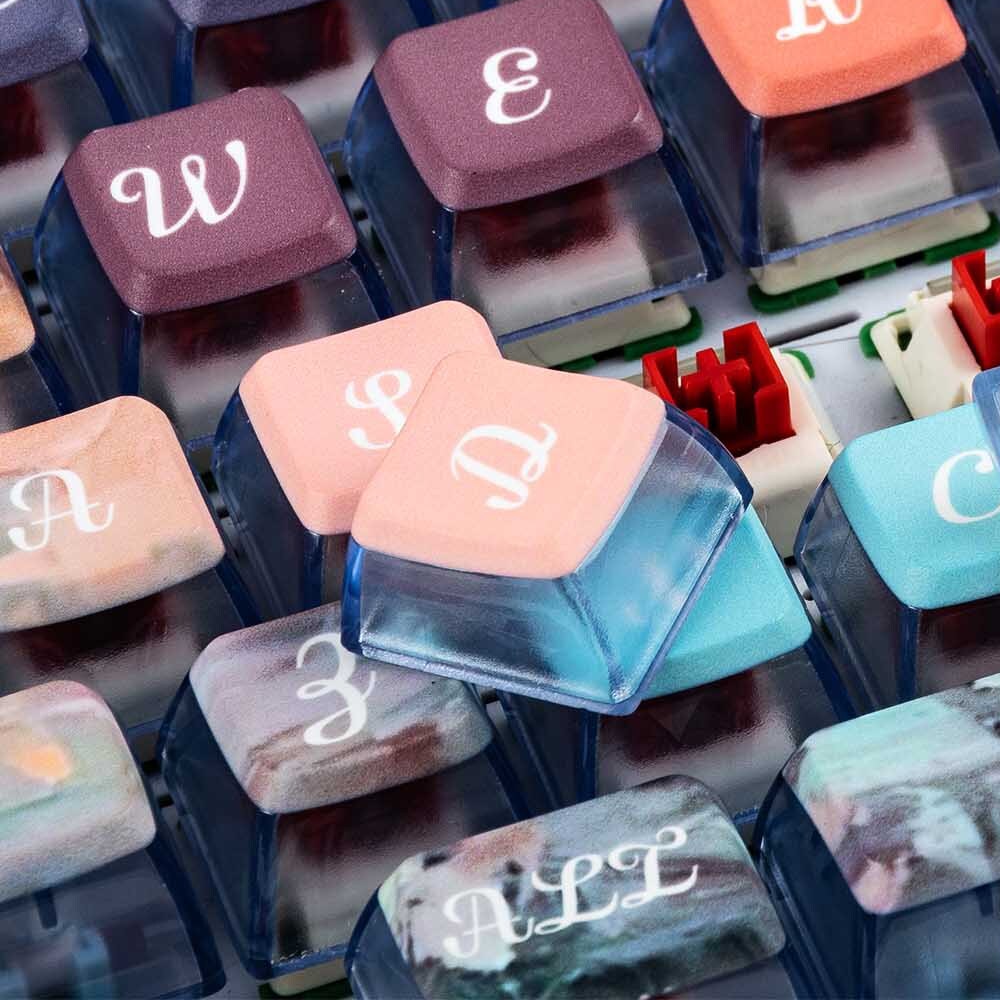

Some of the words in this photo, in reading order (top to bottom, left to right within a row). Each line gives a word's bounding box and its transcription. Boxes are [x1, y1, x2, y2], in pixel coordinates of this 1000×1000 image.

[482, 47, 551, 125] E
[109, 139, 247, 238] W
[7, 469, 115, 551] A
[450, 422, 558, 510] D
[443, 826, 698, 961] ALT
